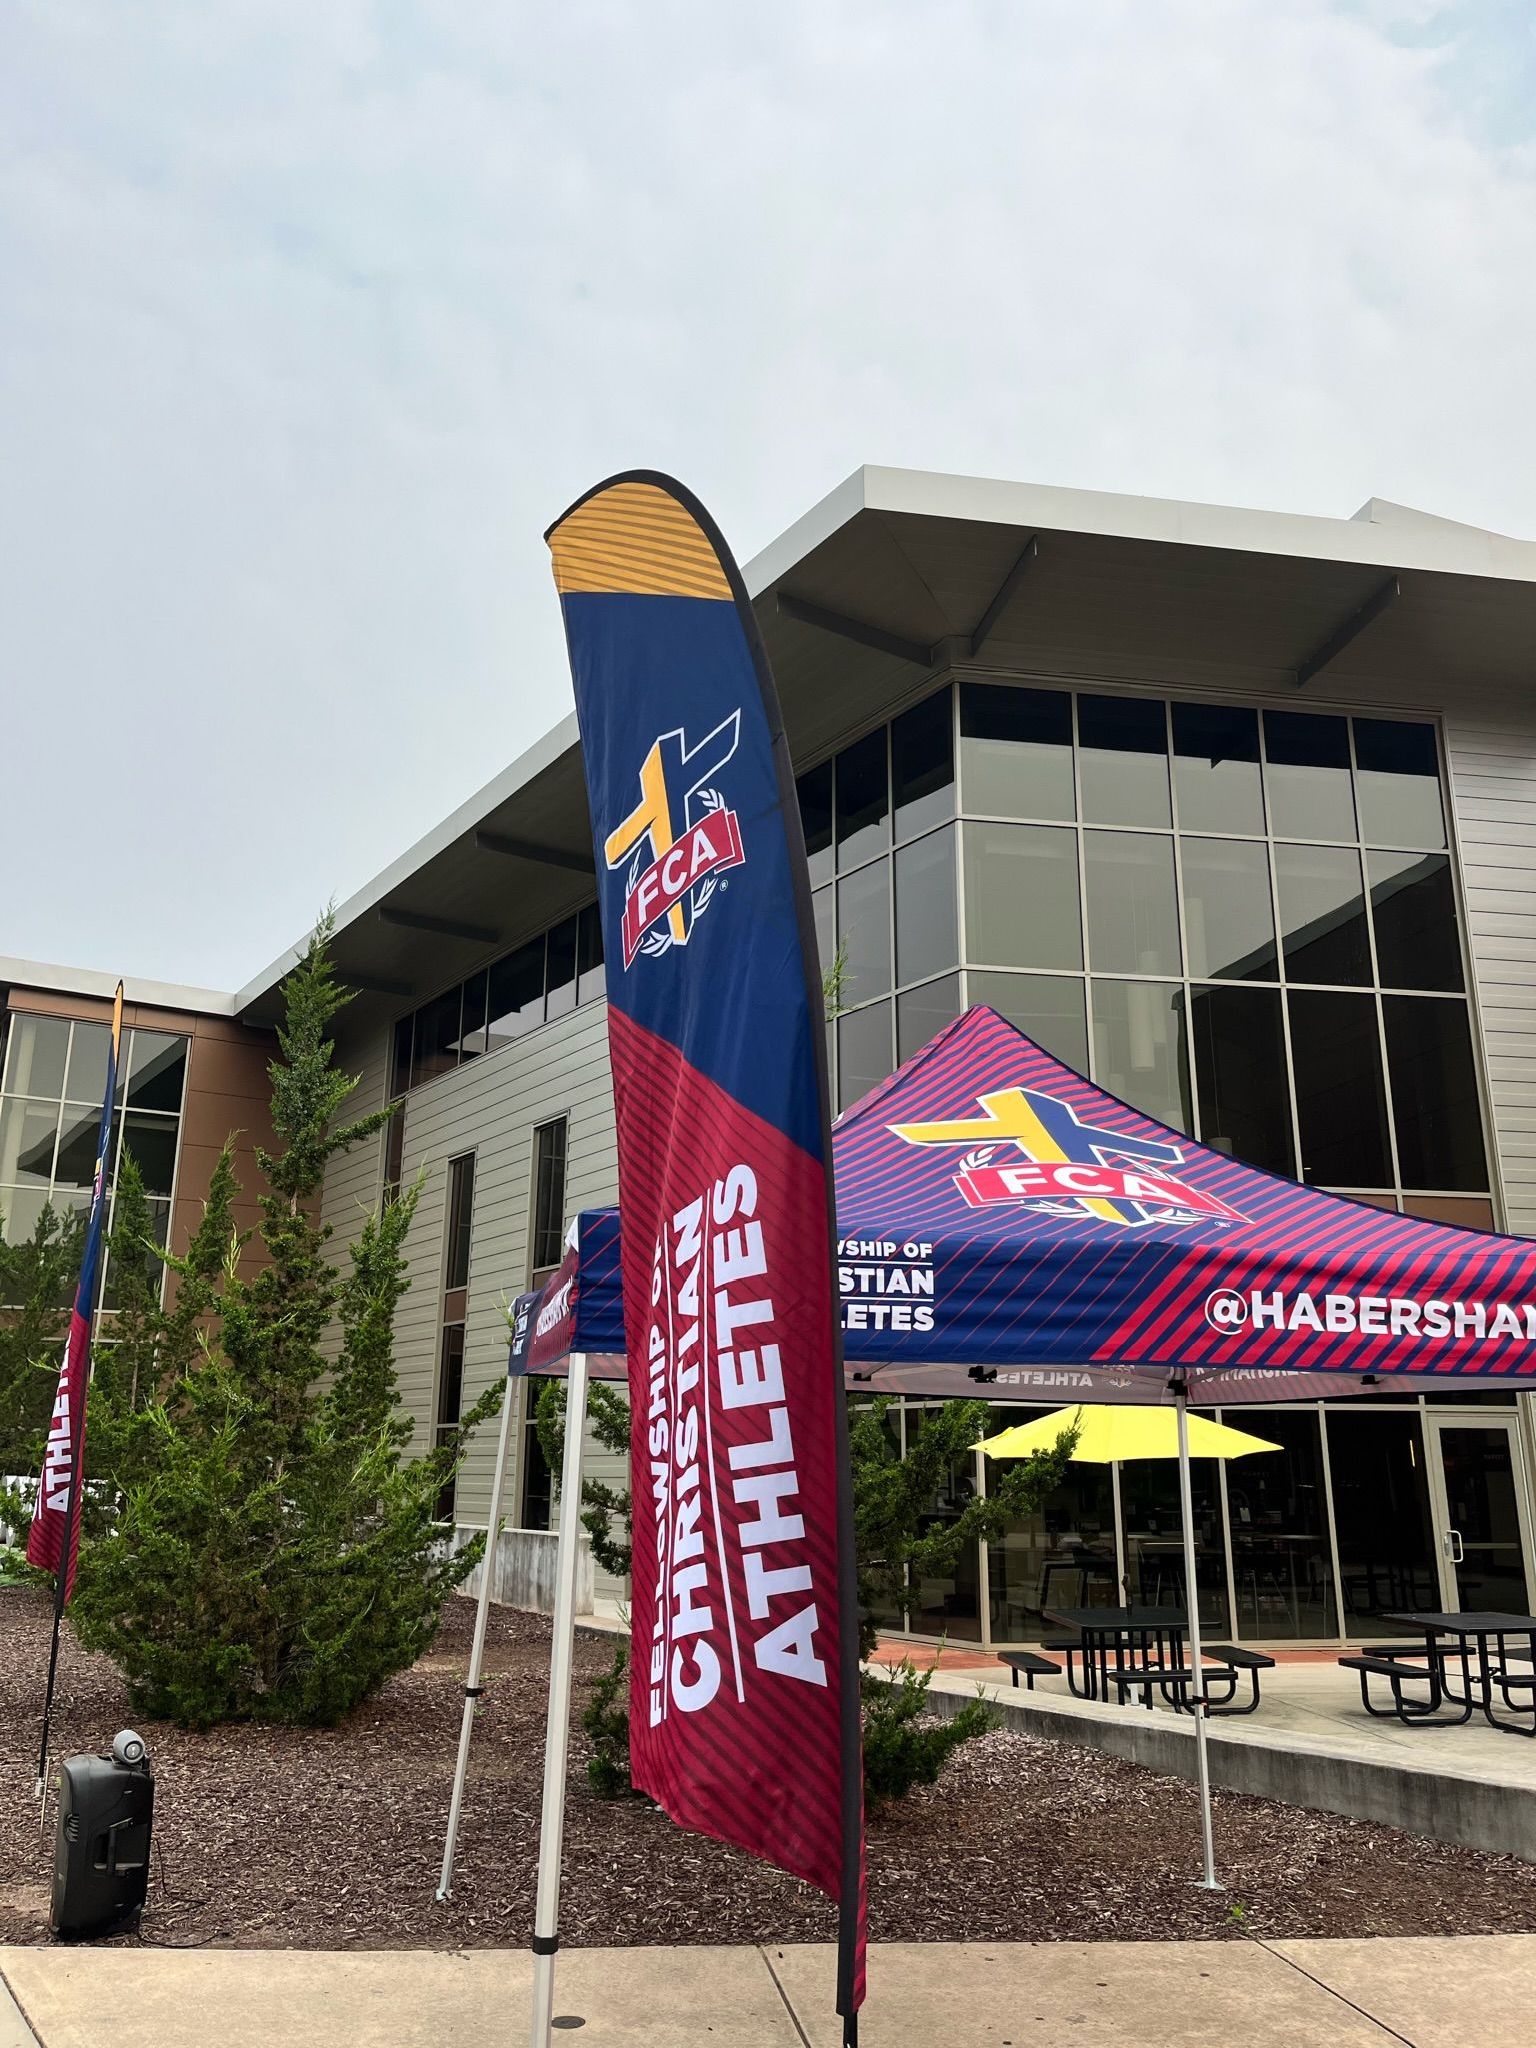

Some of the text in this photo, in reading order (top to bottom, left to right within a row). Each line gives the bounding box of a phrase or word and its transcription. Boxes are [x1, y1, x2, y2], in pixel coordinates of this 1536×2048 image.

[637, 828, 718, 927] FCA
[996, 1166, 1188, 1205] FCA
[903, 1242, 933, 1258] OF
[841, 1304, 935, 1331] ETES
[671, 1195, 721, 1712] CHRISTIAN
[713, 1164, 828, 1687] ATHLETES
[648, 1324, 669, 1728] FELLOWSHIP
